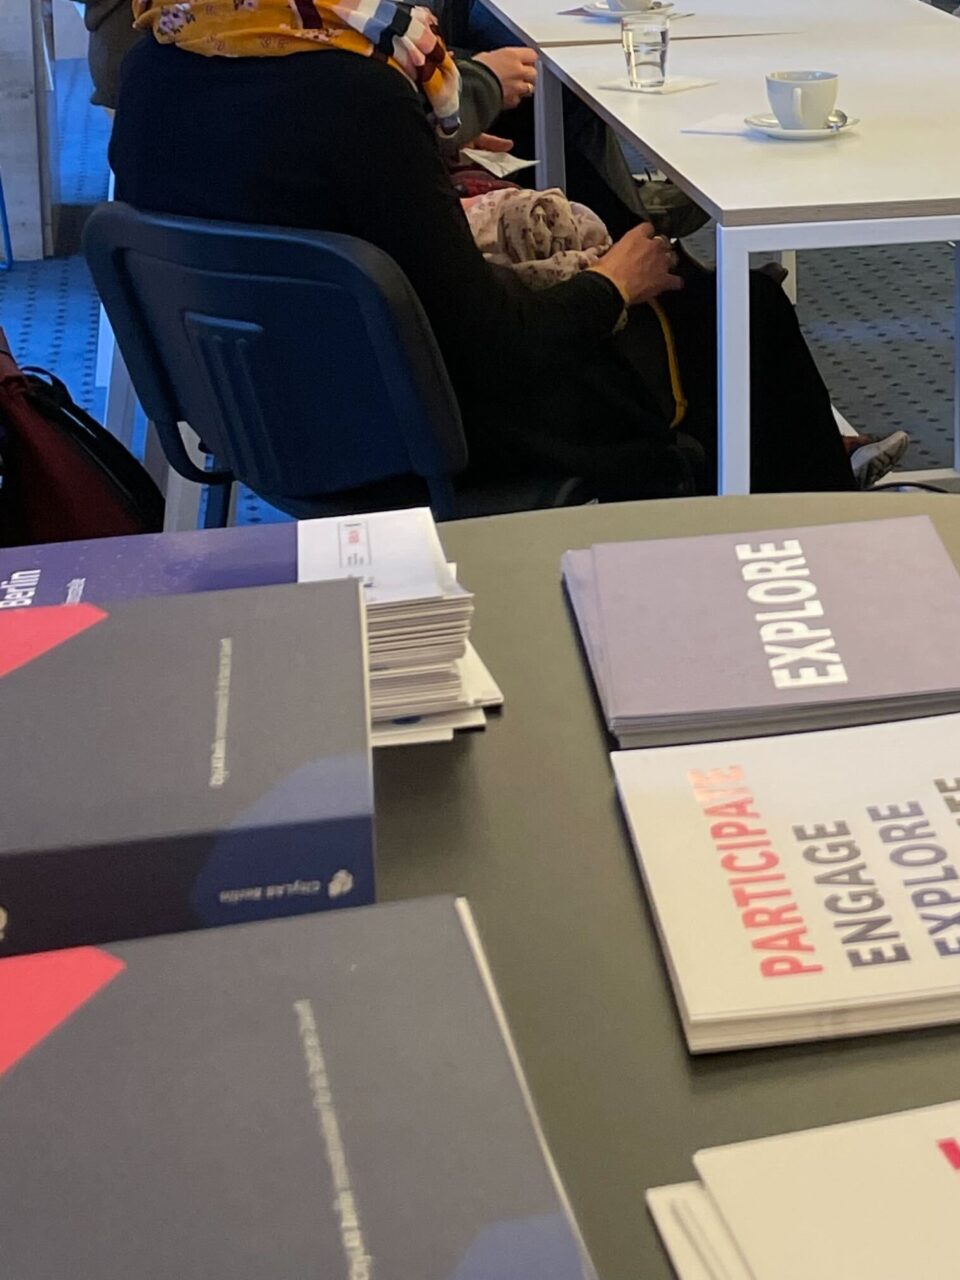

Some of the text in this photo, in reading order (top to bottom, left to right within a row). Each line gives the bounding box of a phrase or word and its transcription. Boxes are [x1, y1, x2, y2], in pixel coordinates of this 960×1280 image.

[0, 570, 41, 609] Berlin
[735, 538, 848, 689] EXPLORE
[688, 765, 823, 978] PARTICIPATE
[792, 819, 911, 968] ENGAGE
